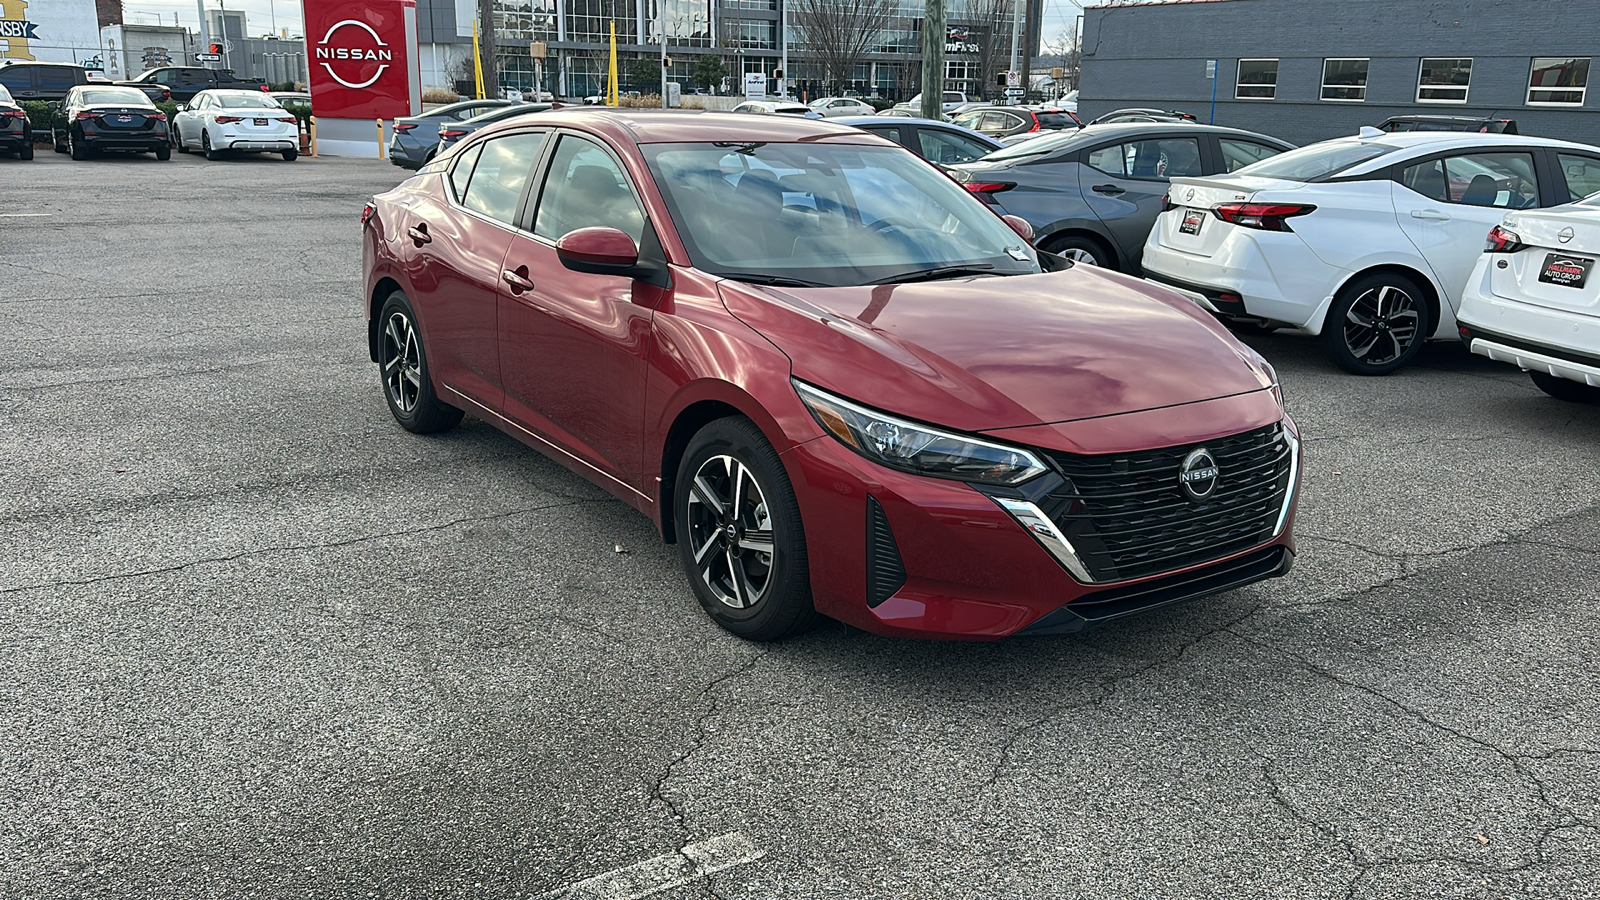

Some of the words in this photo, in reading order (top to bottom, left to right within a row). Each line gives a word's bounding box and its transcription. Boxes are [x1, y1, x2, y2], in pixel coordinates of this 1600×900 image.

[945, 41, 979, 52] mFirst
[316, 47, 391, 60] NISSAN
[1547, 264, 1581, 274] HALLMARK
[1544, 270, 1560, 278] AUTO
[1561, 272, 1581, 281] GROUP
[1182, 468, 1218, 482] NISSAN
